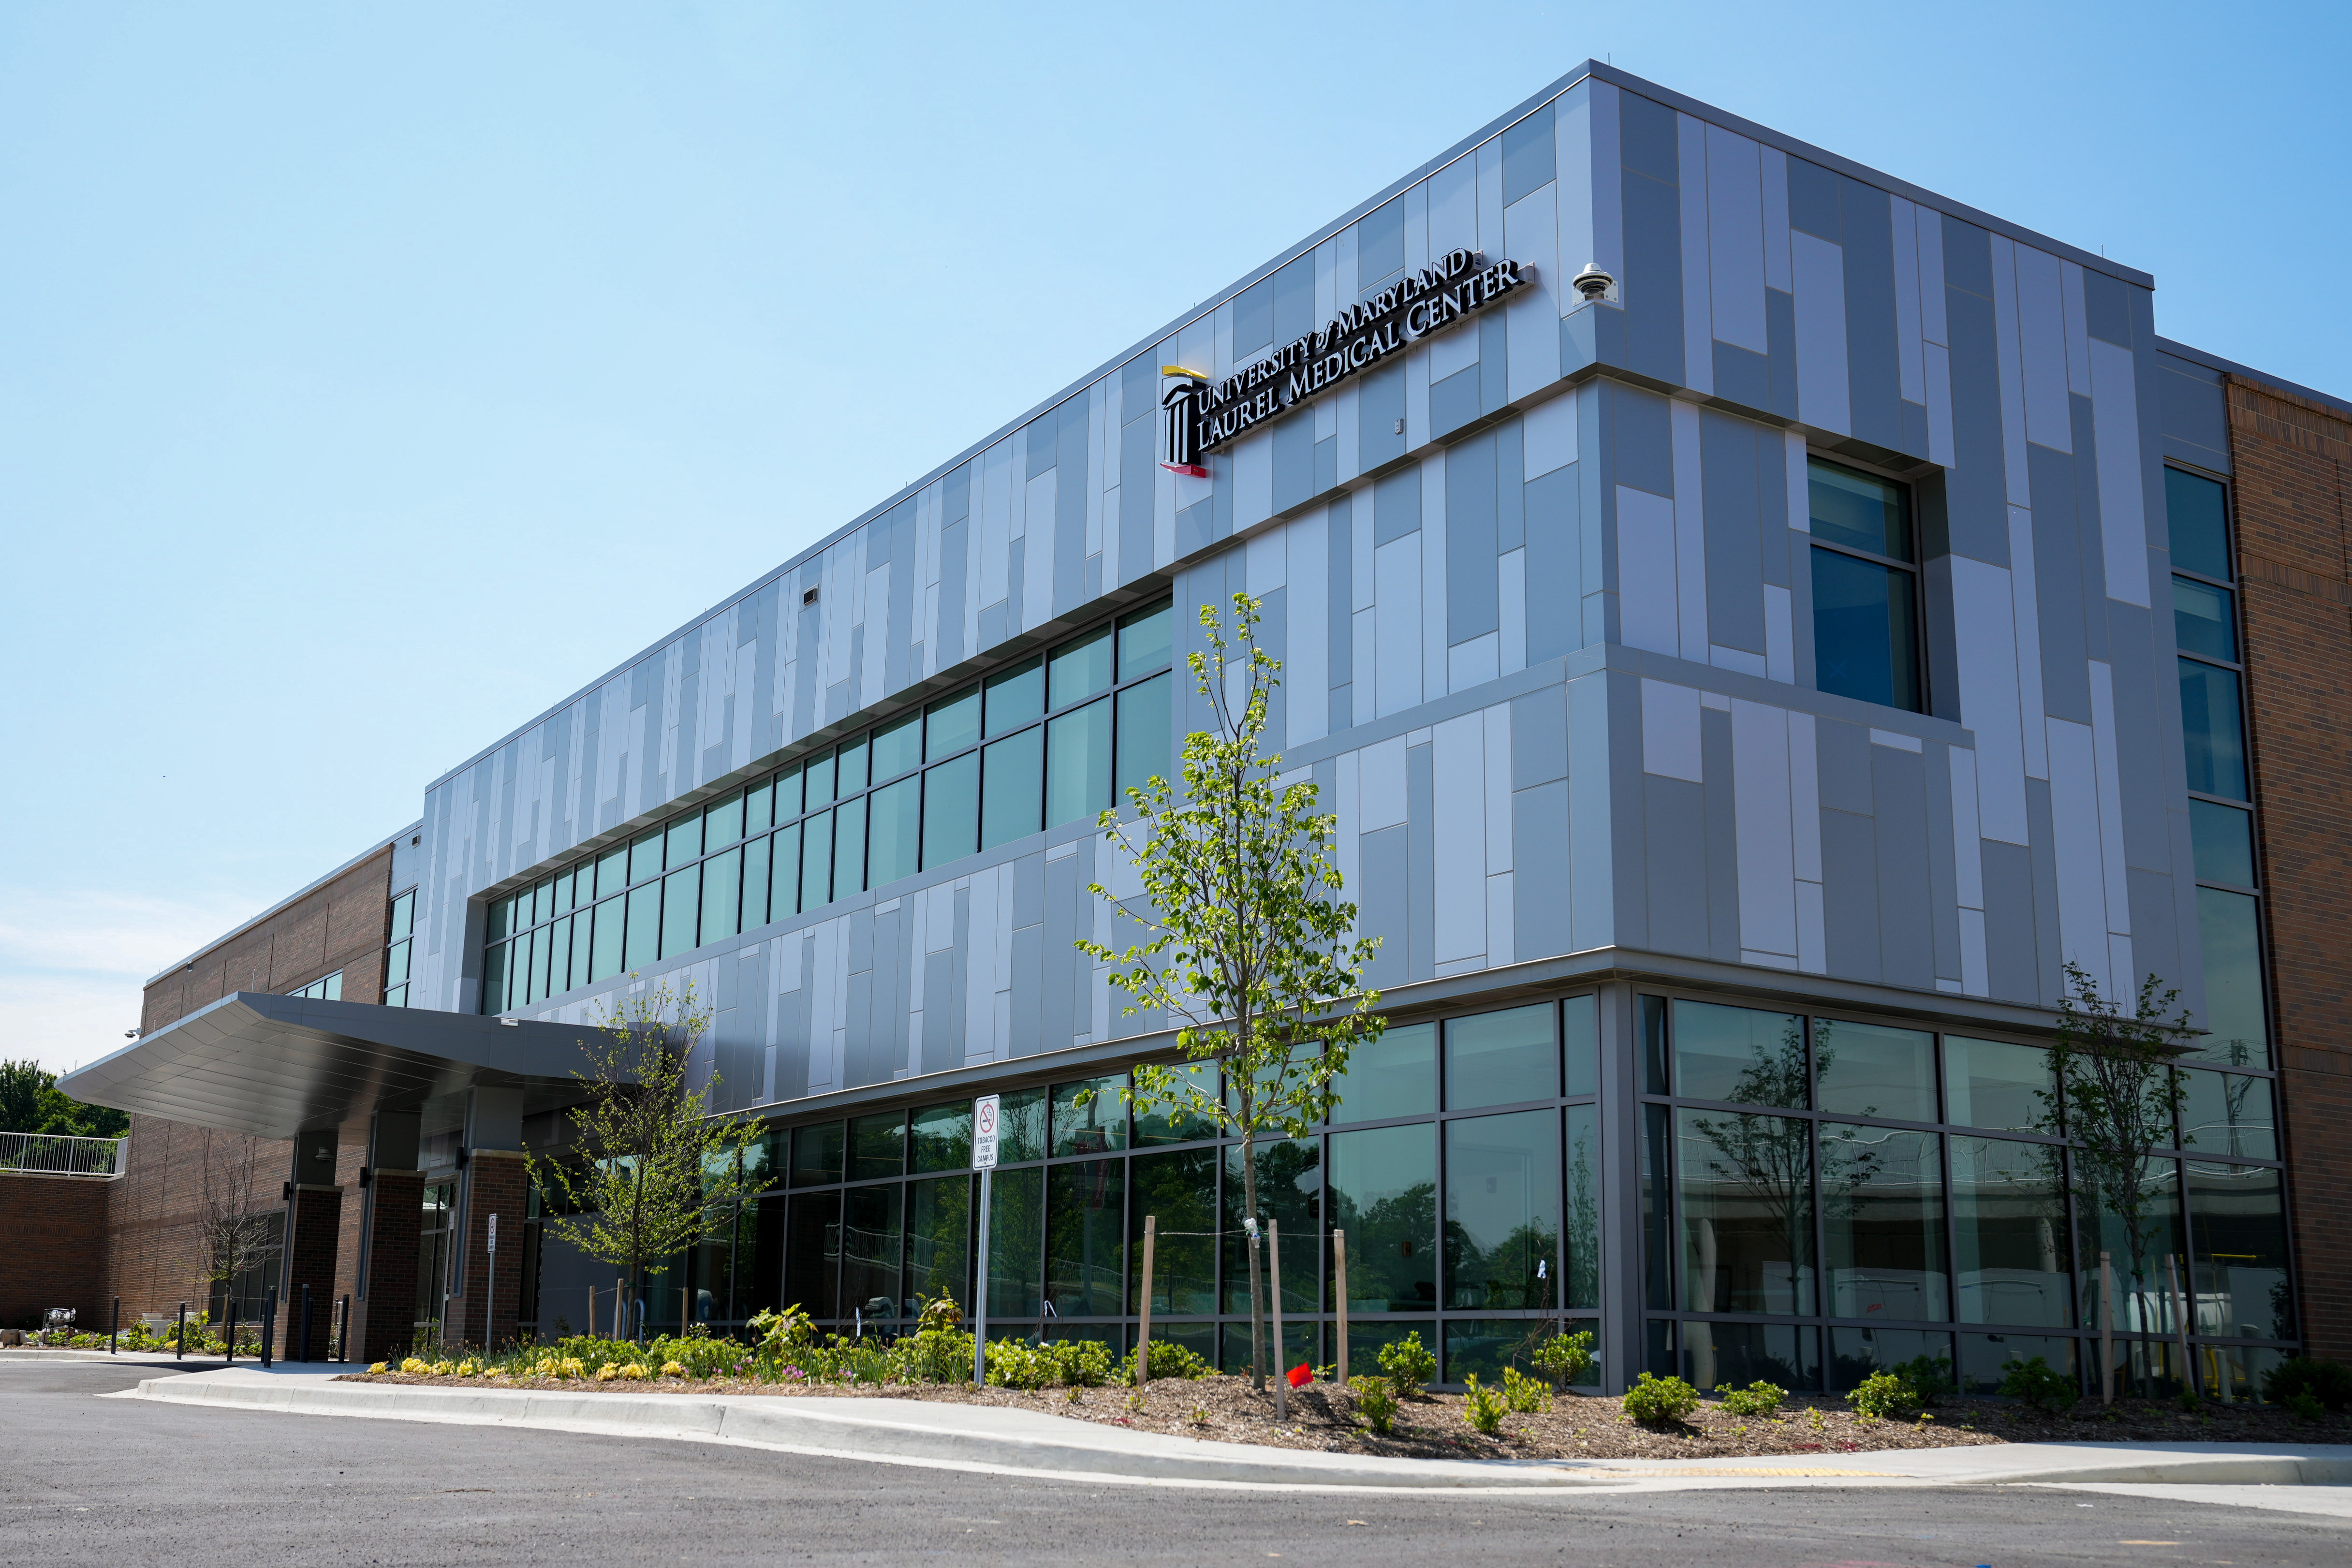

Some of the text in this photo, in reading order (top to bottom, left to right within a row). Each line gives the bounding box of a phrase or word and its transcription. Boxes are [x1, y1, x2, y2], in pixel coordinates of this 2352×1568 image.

[1197, 247, 1469, 415] UNIVERSITY of MARYLAND
[1197, 258, 1519, 452] LAUREL MEDICAL CENTER
[977, 1154, 993, 1162] CAMPUS
[978, 1135, 995, 1144] TOBACCO
